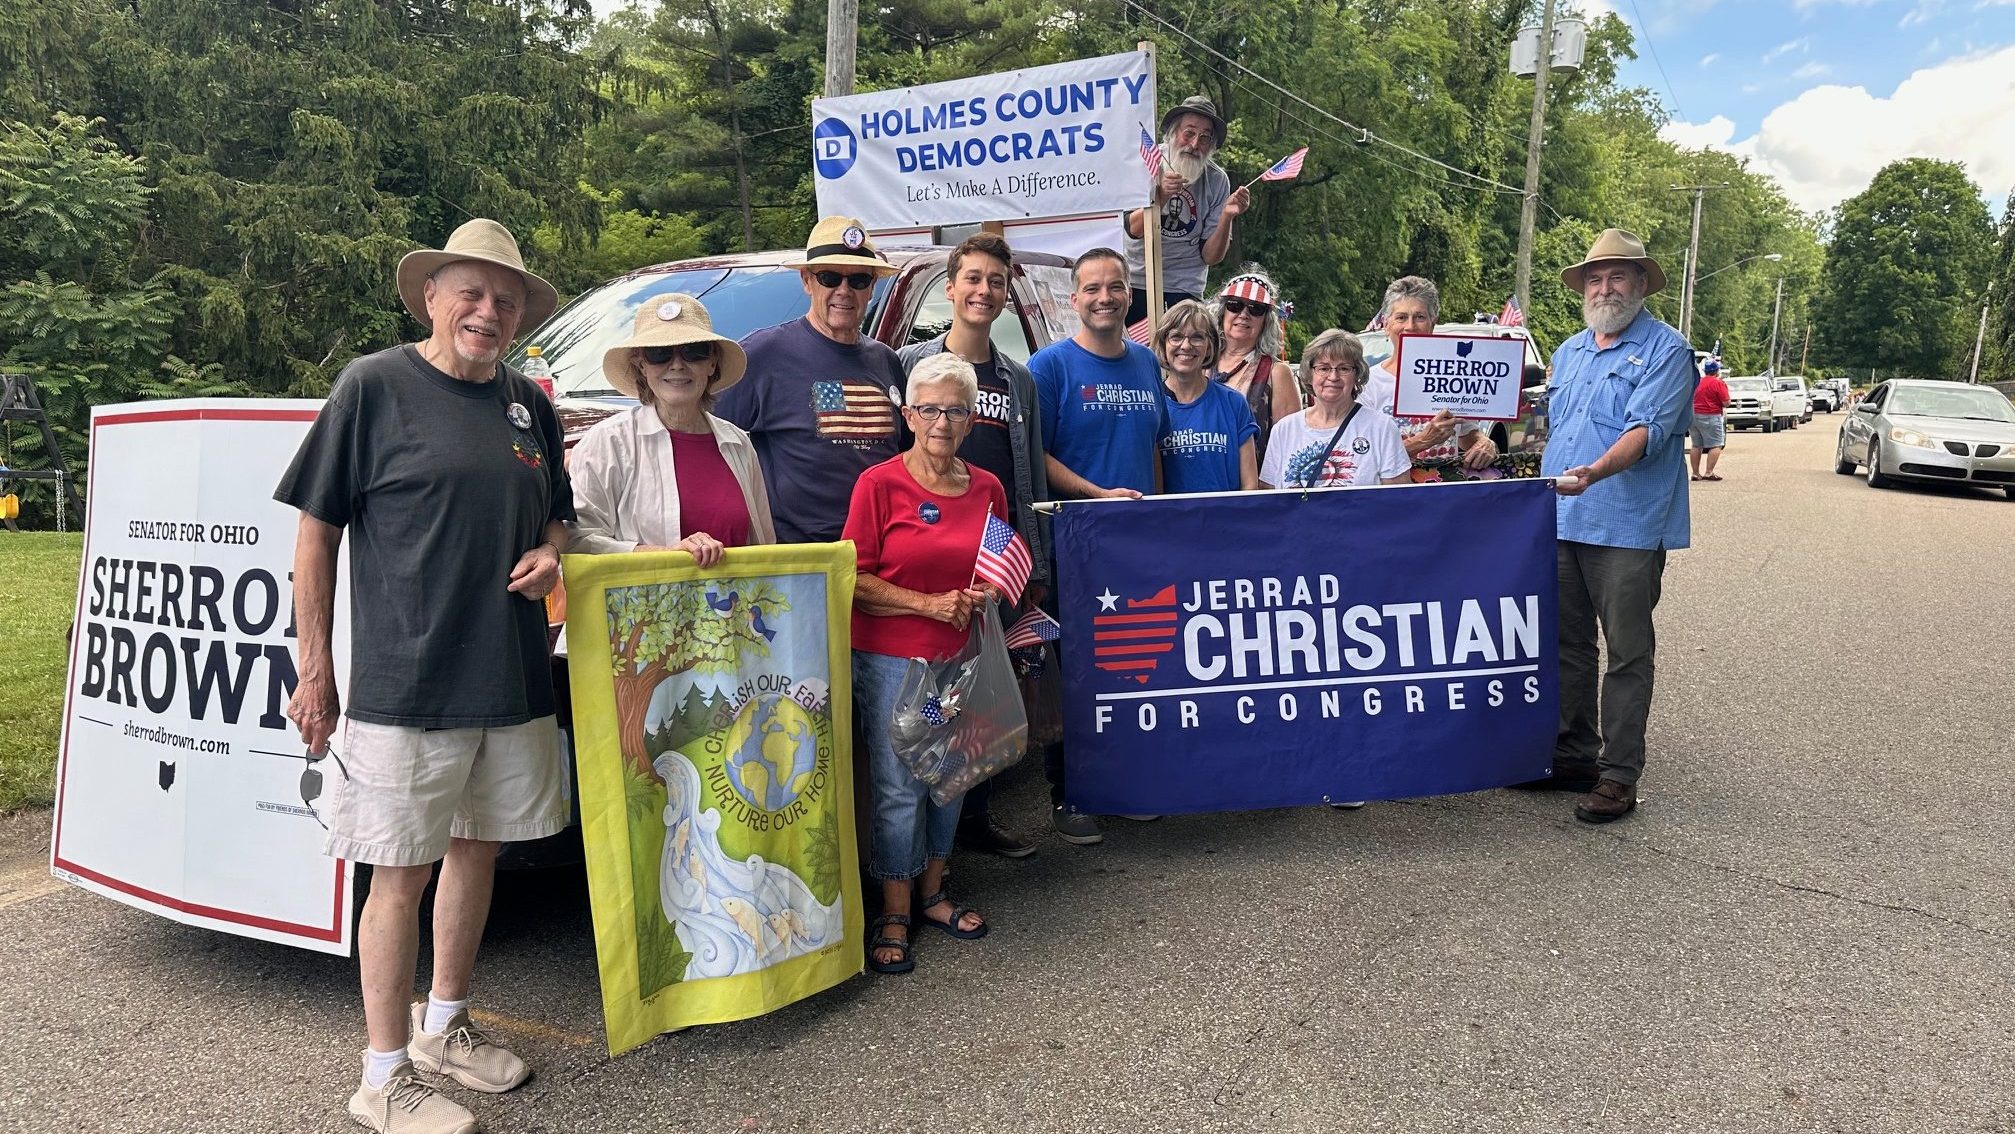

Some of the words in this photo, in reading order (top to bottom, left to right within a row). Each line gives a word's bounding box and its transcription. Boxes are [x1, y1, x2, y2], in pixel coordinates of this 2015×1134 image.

[861, 97, 987, 140] HOLMES
[996, 73, 1148, 122] COUNTY
[826, 139, 841, 158] D
[896, 122, 1105, 173] DEMOCRATS
[907, 182, 941, 202] Let's
[946, 179, 987, 199] Make
[991, 178, 1003, 195] A
[1008, 171, 1101, 198] Difference.
[1413, 358, 1510, 378] SHERROD
[1096, 389, 1155, 403] CHRISTIAN
[1422, 377, 1499, 395] BROWN
[1431, 395, 1461, 403] Senator
[1460, 396, 1471, 405] for
[1472, 396, 1489, 405] Ohio
[1163, 432, 1227, 447] CHRISTIAN
[128, 520, 178, 543] SENATOR
[179, 523, 205, 544] FOR
[210, 524, 259, 546] OHIO
[1182, 573, 1340, 612] JERRAD
[1184, 595, 1540, 681] CHRISTIAN
[757, 673, 792, 695] OUR
[1095, 700, 1199, 733] FOR
[1237, 676, 1540, 724] CONGRESS
[123, 719, 230, 756] sherrodbrown.com
[773, 800, 808, 831] OUR
